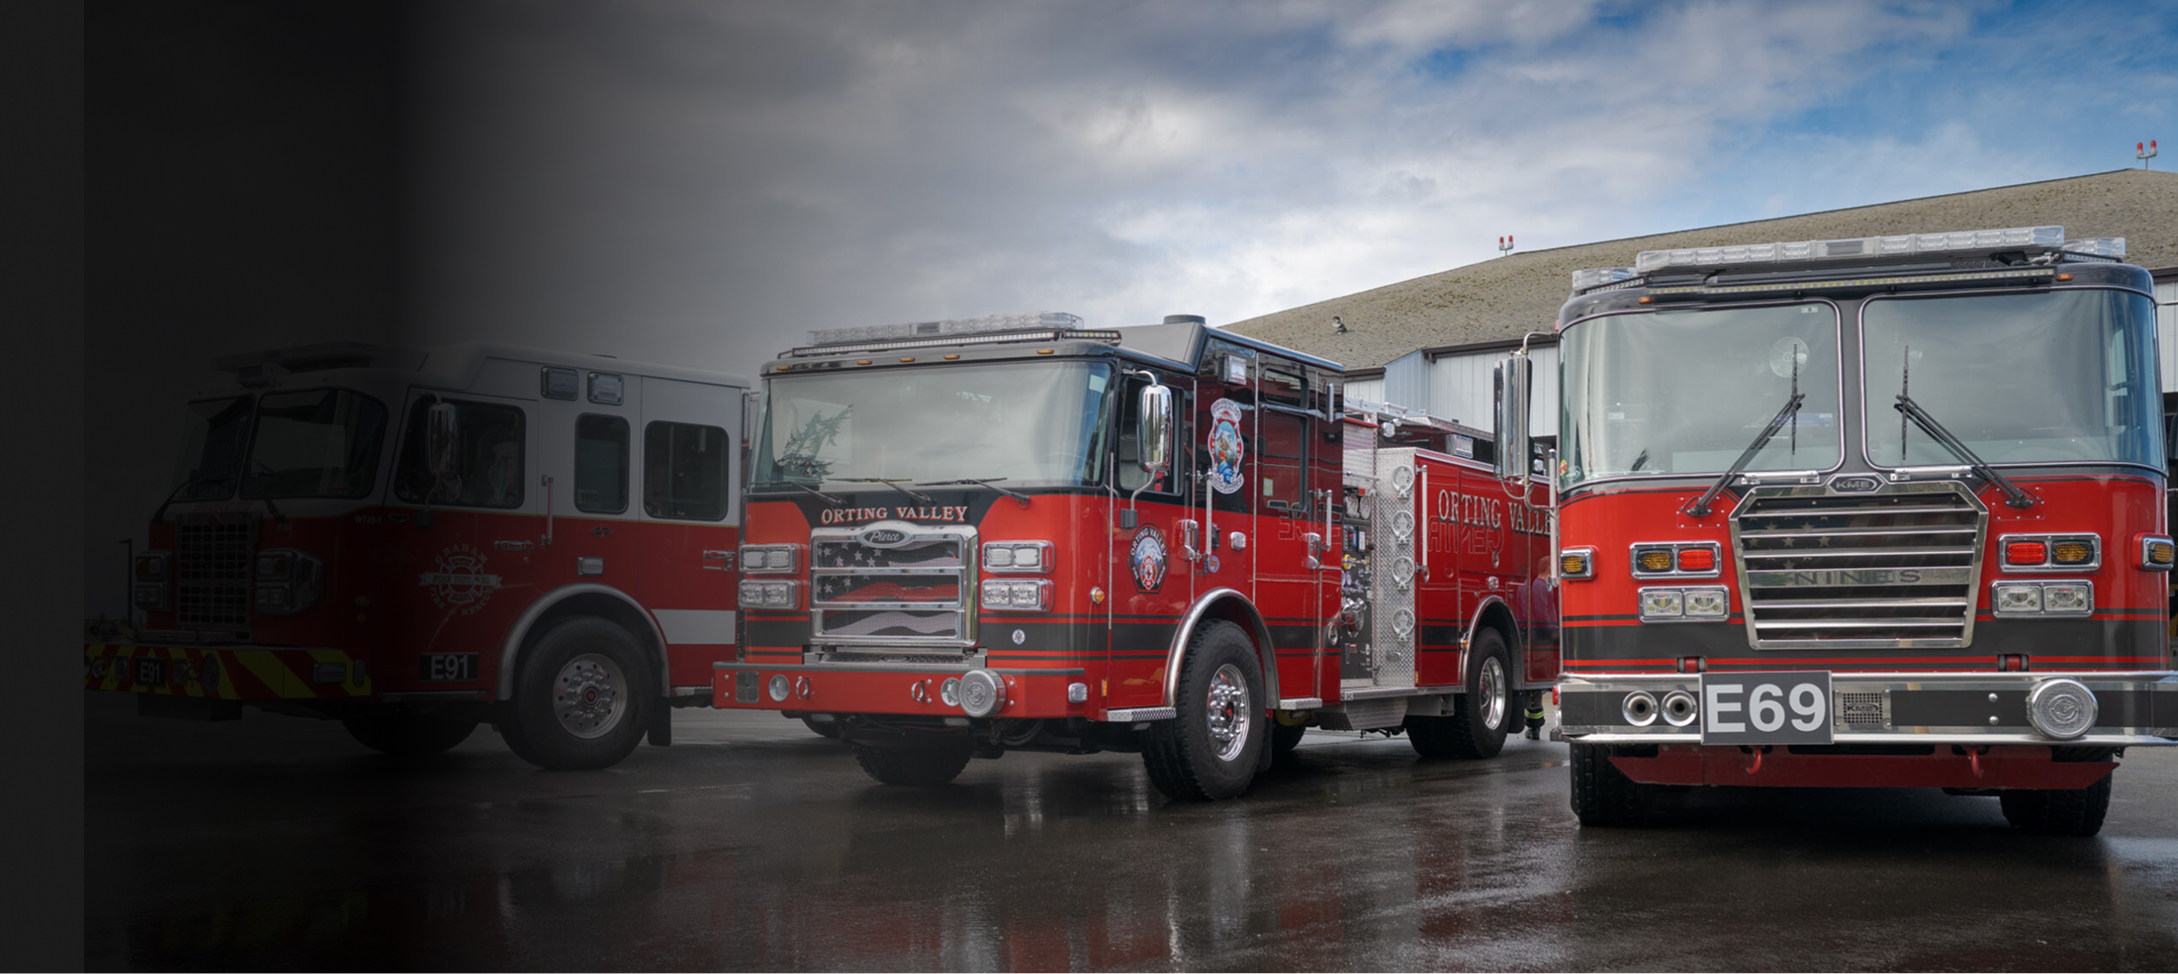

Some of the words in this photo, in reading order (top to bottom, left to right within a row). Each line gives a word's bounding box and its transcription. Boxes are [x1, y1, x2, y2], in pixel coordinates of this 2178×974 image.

[1836, 480, 1872, 489] KME
[820, 507, 888, 525] ORTING
[895, 506, 968, 523] VALLEY
[1438, 488, 1502, 530] ORTING
[1507, 501, 1551, 538] VALLE
[869, 530, 901, 543] Pierce
[434, 543, 489, 565] GRAHAM
[1793, 570, 1922, 585] NINES
[461, 587, 493, 616] RESCUE
[140, 661, 160, 683] E91
[431, 654, 469, 680] E91
[1705, 682, 1827, 733] E69
